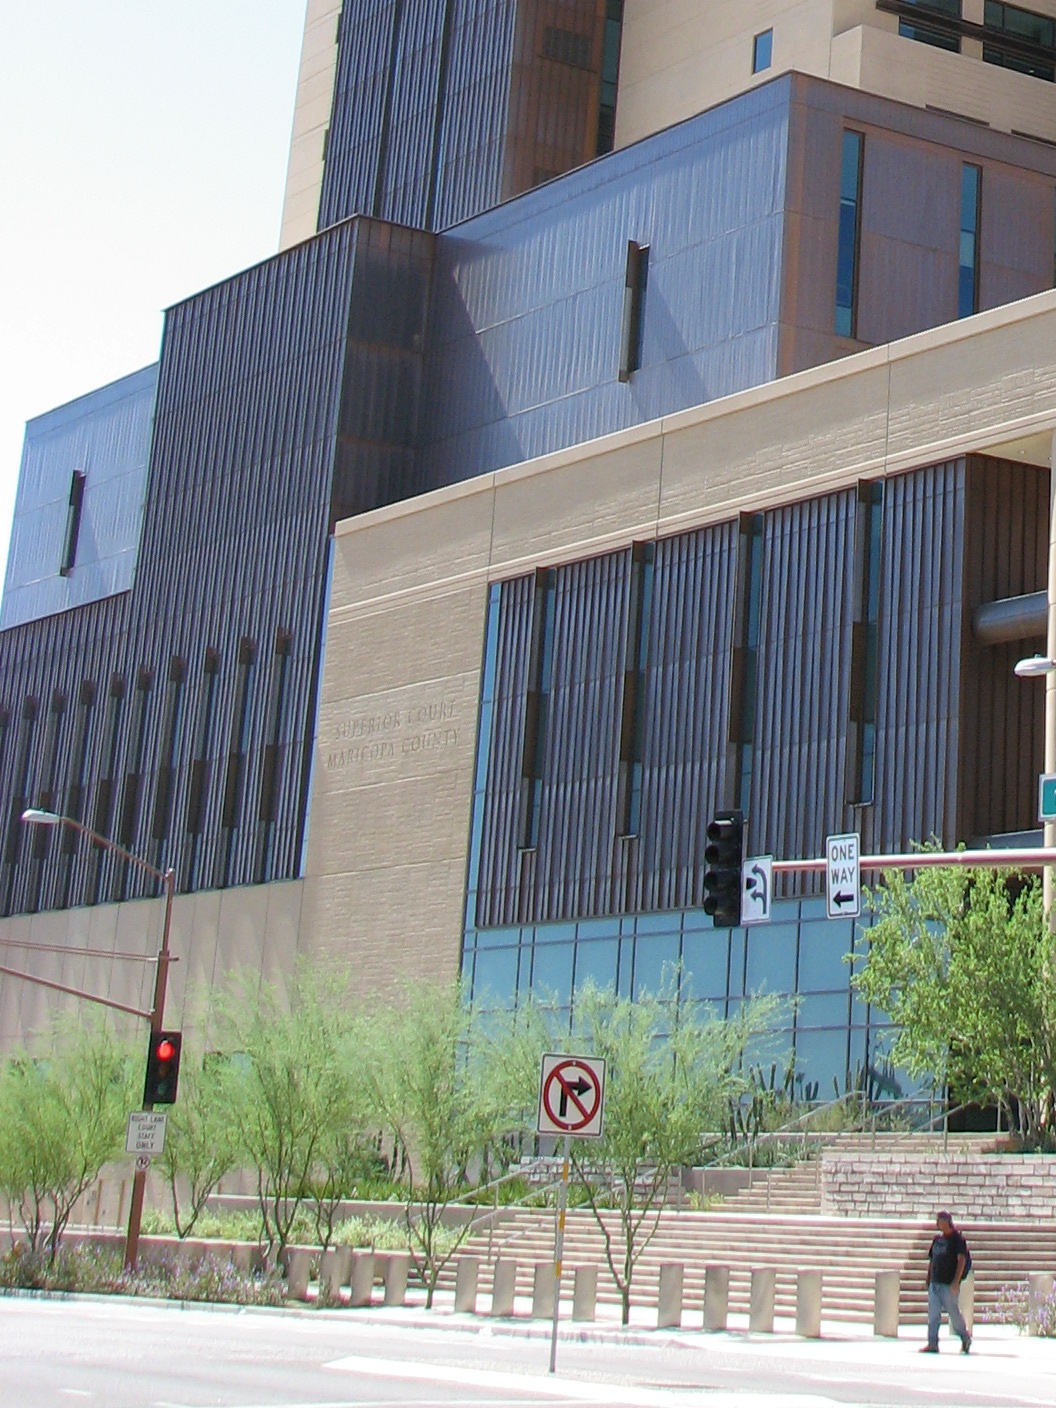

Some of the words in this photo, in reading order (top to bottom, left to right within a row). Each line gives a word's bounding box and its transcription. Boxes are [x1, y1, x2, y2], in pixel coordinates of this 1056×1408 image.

[335, 712, 400, 740] SUPERIOR
[407, 700, 457, 724] COURT
[327, 742, 395, 768] MARICOPA
[401, 728, 460, 753] COUNTY
[831, 844, 854, 862] ONE
[831, 867, 855, 885] WAY
